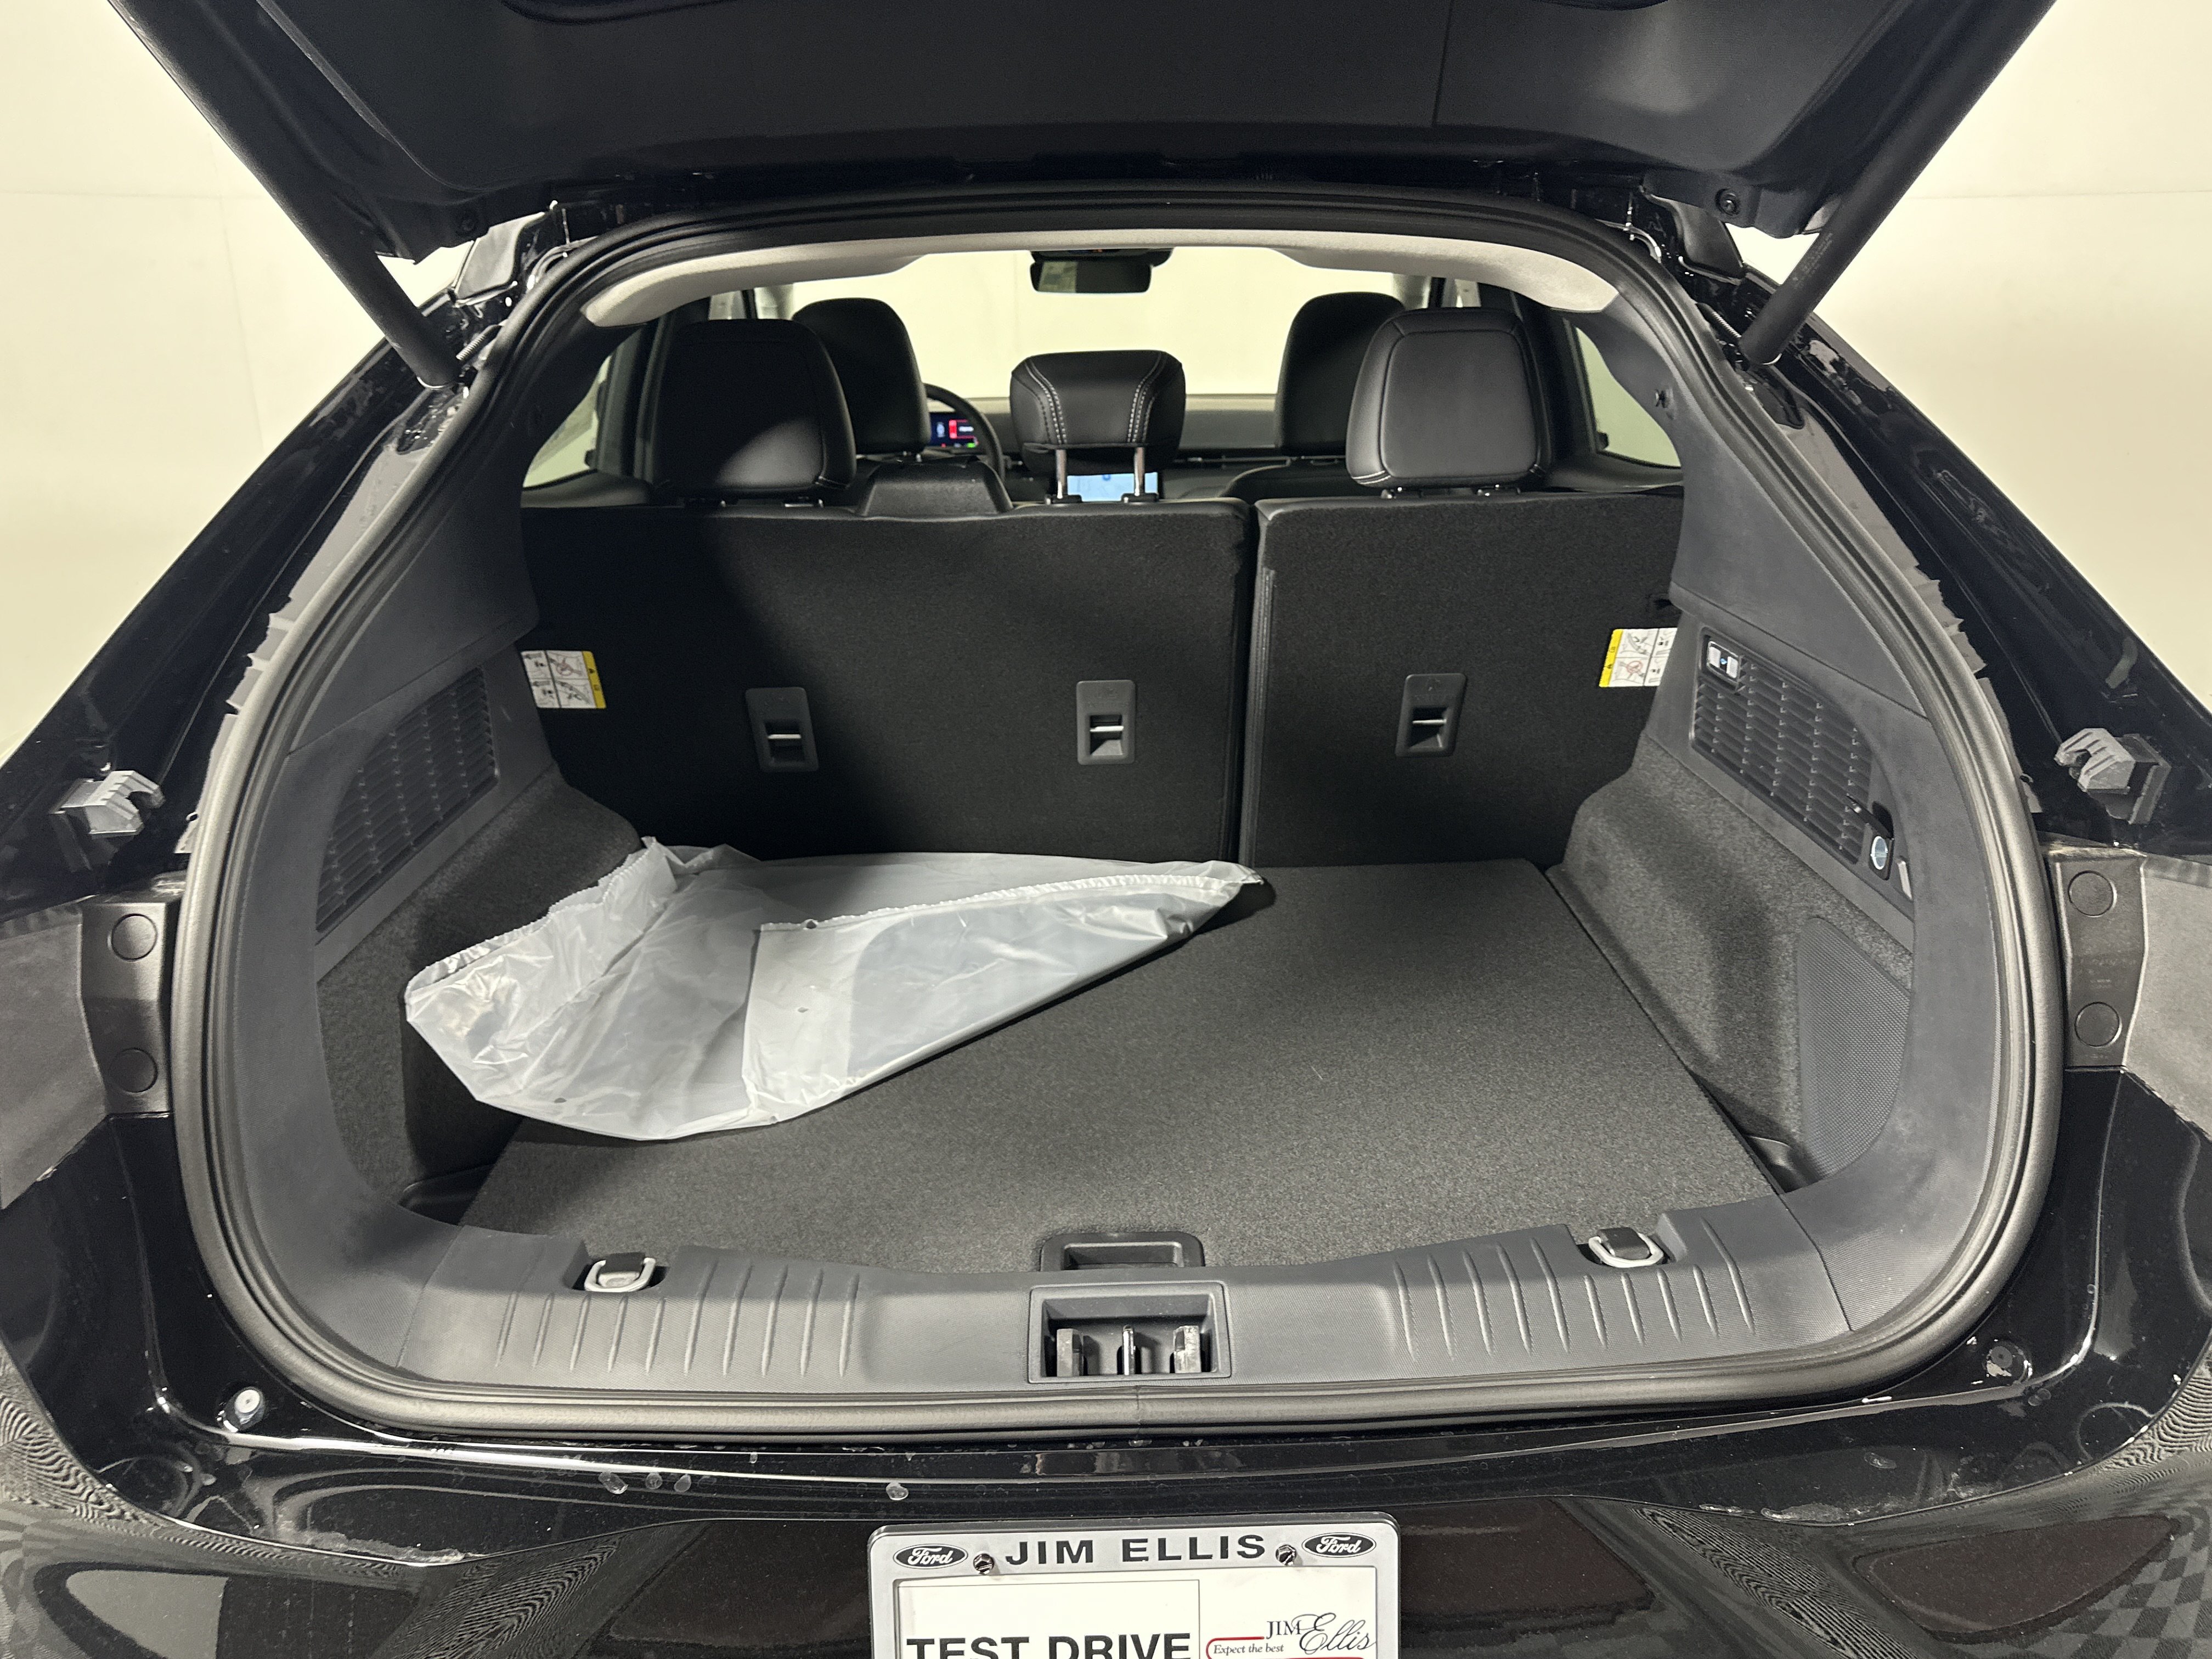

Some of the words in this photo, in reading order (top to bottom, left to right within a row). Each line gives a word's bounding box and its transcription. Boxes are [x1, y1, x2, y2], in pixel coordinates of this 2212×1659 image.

[907, 1547, 954, 1565] Ford
[1005, 1539, 1093, 1566] JIM
[1122, 1534, 1266, 1562] ELLIS
[1316, 1536, 1362, 1554] Ford
[1266, 1620, 1302, 1640] JIM
[1291, 1612, 1376, 1655] Ellis
[906, 1636, 1030, 1659] TEST
[1048, 1633, 1191, 1659] DRIVE
[1214, 1644, 1245, 1656] Expect
[1248, 1643, 1262, 1653] the
[1265, 1643, 1284, 1653] best
